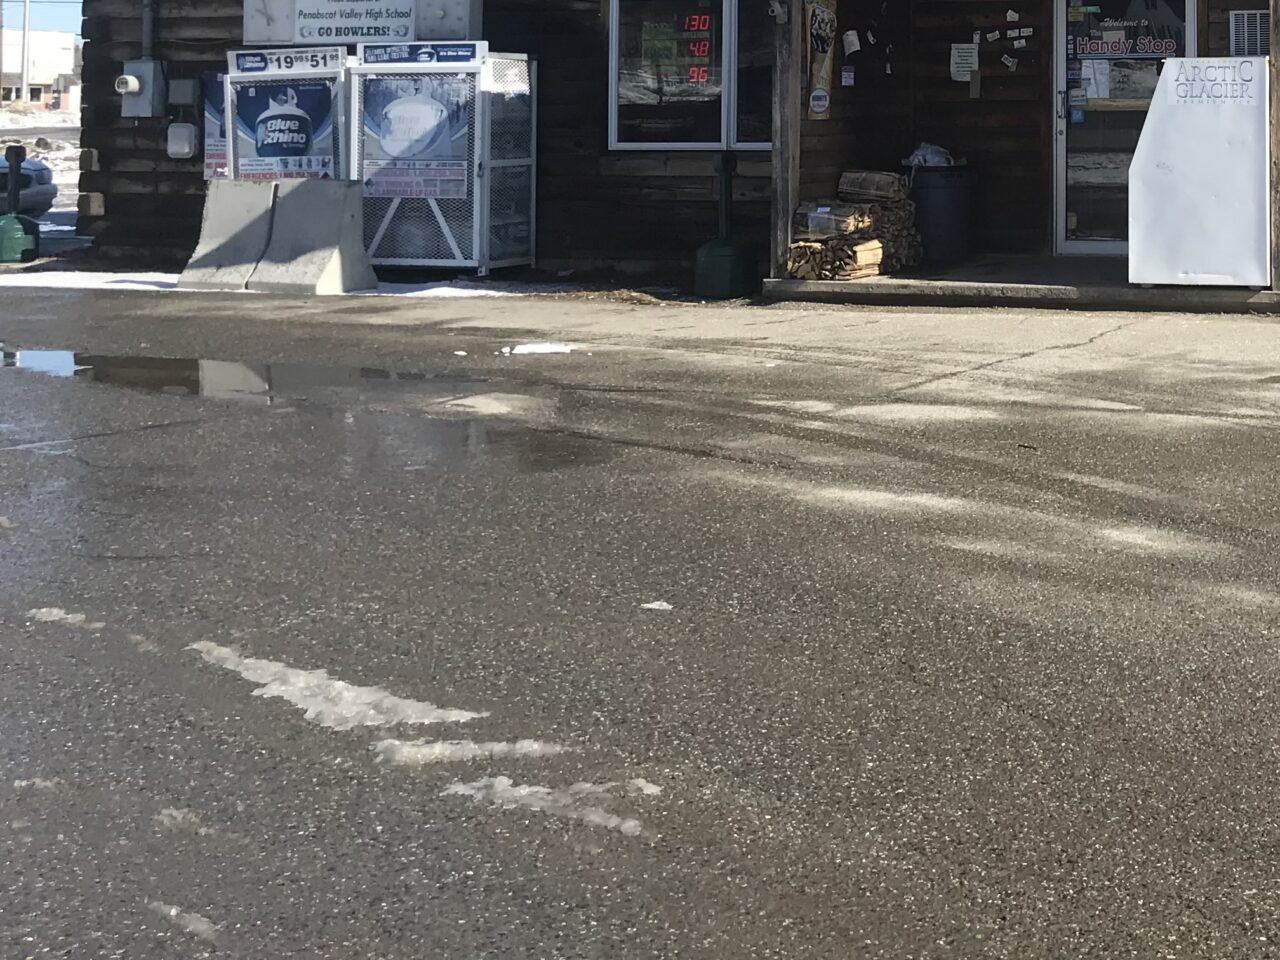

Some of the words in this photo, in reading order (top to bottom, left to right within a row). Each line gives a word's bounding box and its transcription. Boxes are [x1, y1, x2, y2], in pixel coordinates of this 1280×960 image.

[339, 8, 363, 20] Valley
[365, 8, 383, 21] High
[385, 7, 412, 18] School
[684, 15, 710, 31] 130
[1100, 17, 1138, 27] Welcome
[1141, 18, 1148, 26] to
[318, 27, 333, 37] GO
[335, 26, 390, 37] HOWLERS!
[1076, 37, 1133, 55] Handy
[1136, 35, 1177, 54] Stop
[1174, 60, 1253, 82] ARCTIC
[1175, 83, 1253, 99] GLACIER
[267, 119, 299, 131] Blue
